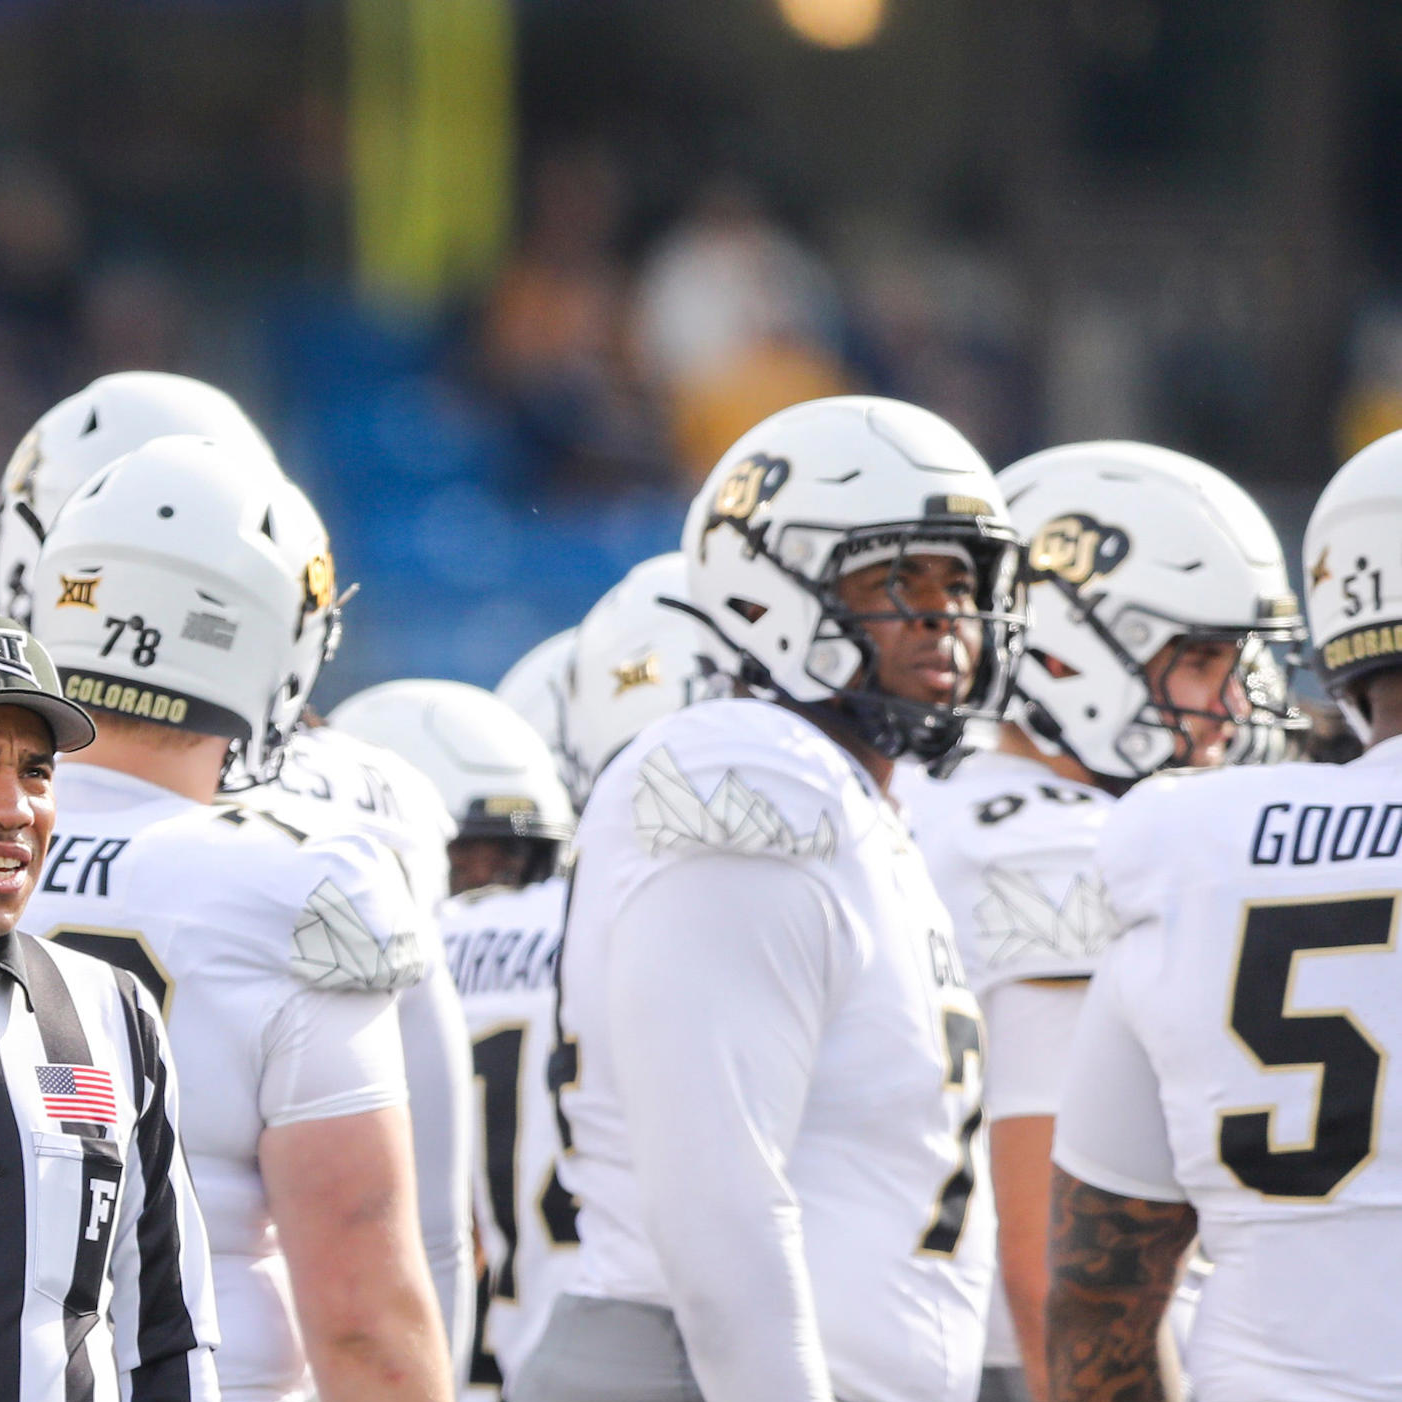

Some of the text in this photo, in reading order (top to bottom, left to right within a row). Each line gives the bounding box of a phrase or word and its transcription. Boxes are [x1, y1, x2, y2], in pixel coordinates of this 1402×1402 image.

[57, 575, 101, 610] XII
[1342, 569, 1383, 618] 51
[101, 617, 162, 668] 78
[64, 674, 189, 724] COLORADO
[84, 1177, 118, 1242] F
